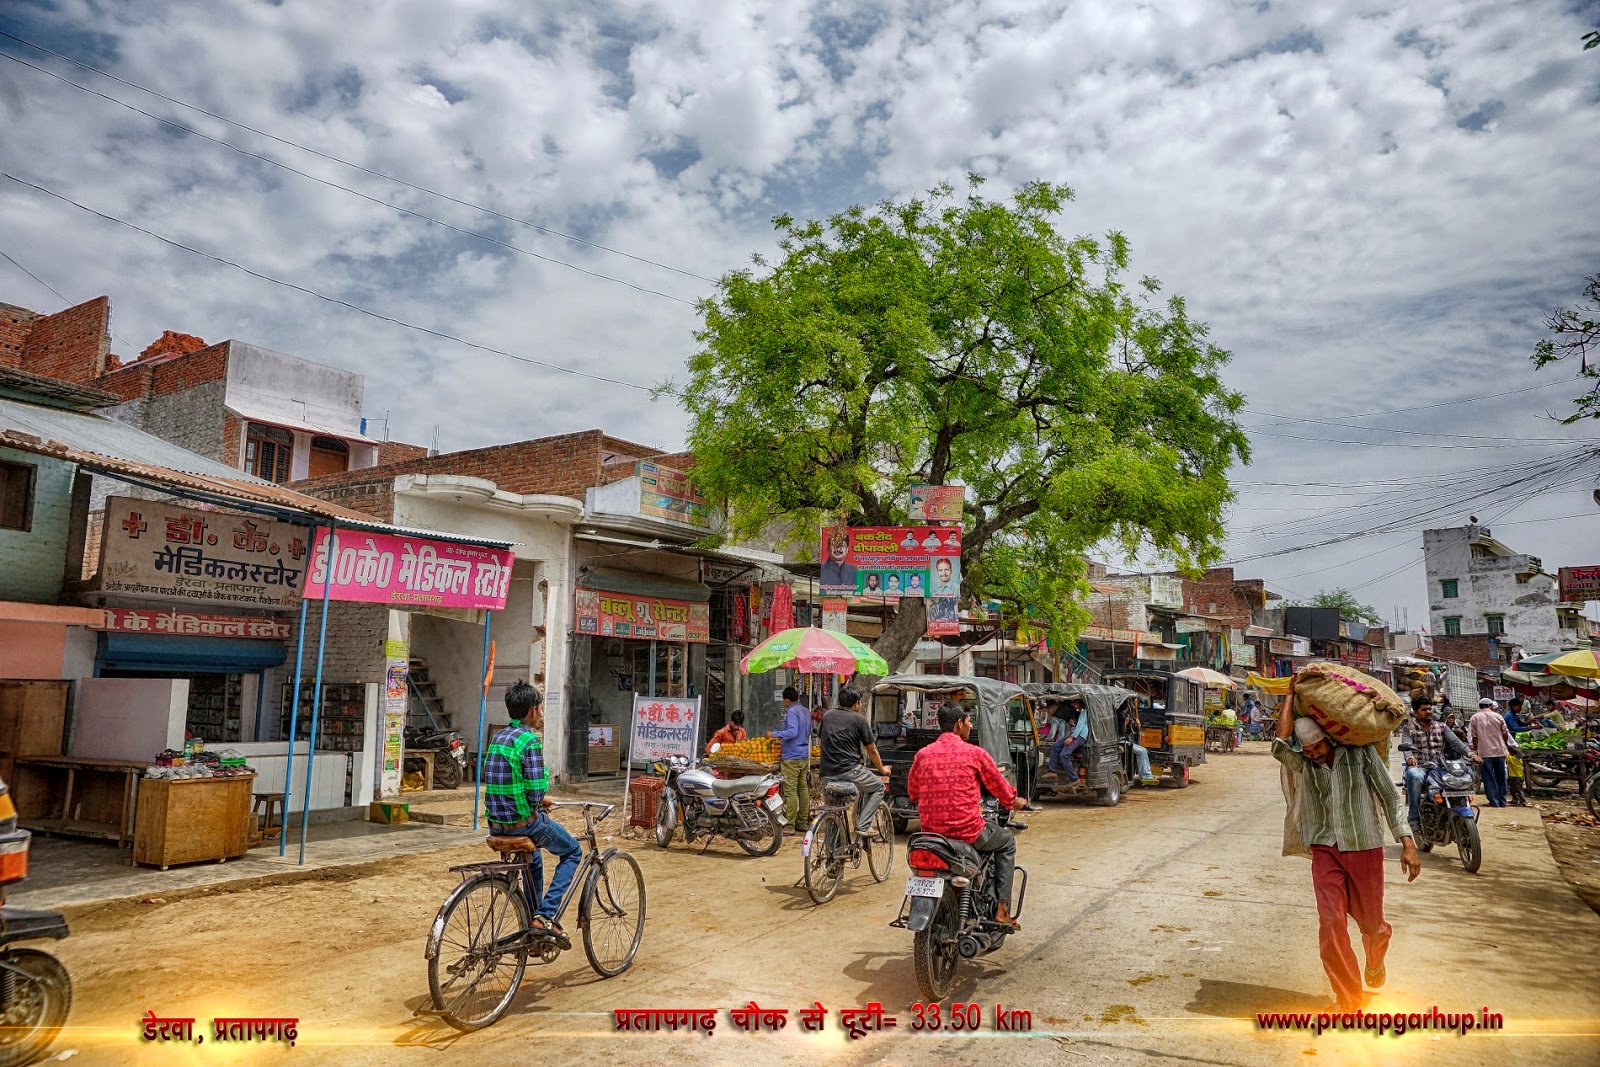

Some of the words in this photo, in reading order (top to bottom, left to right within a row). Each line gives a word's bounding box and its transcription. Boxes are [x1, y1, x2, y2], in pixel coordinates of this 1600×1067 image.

[854, 531, 893, 542] बकरीद
[852, 542, 899, 554] दीपावली
[397, 542, 472, 596] मेडिकल
[474, 553, 511, 599] स्टोर
[123, 611, 151, 631] के.
[155, 611, 246, 636] मेडिकल
[247, 616, 290, 638] स्टोर
